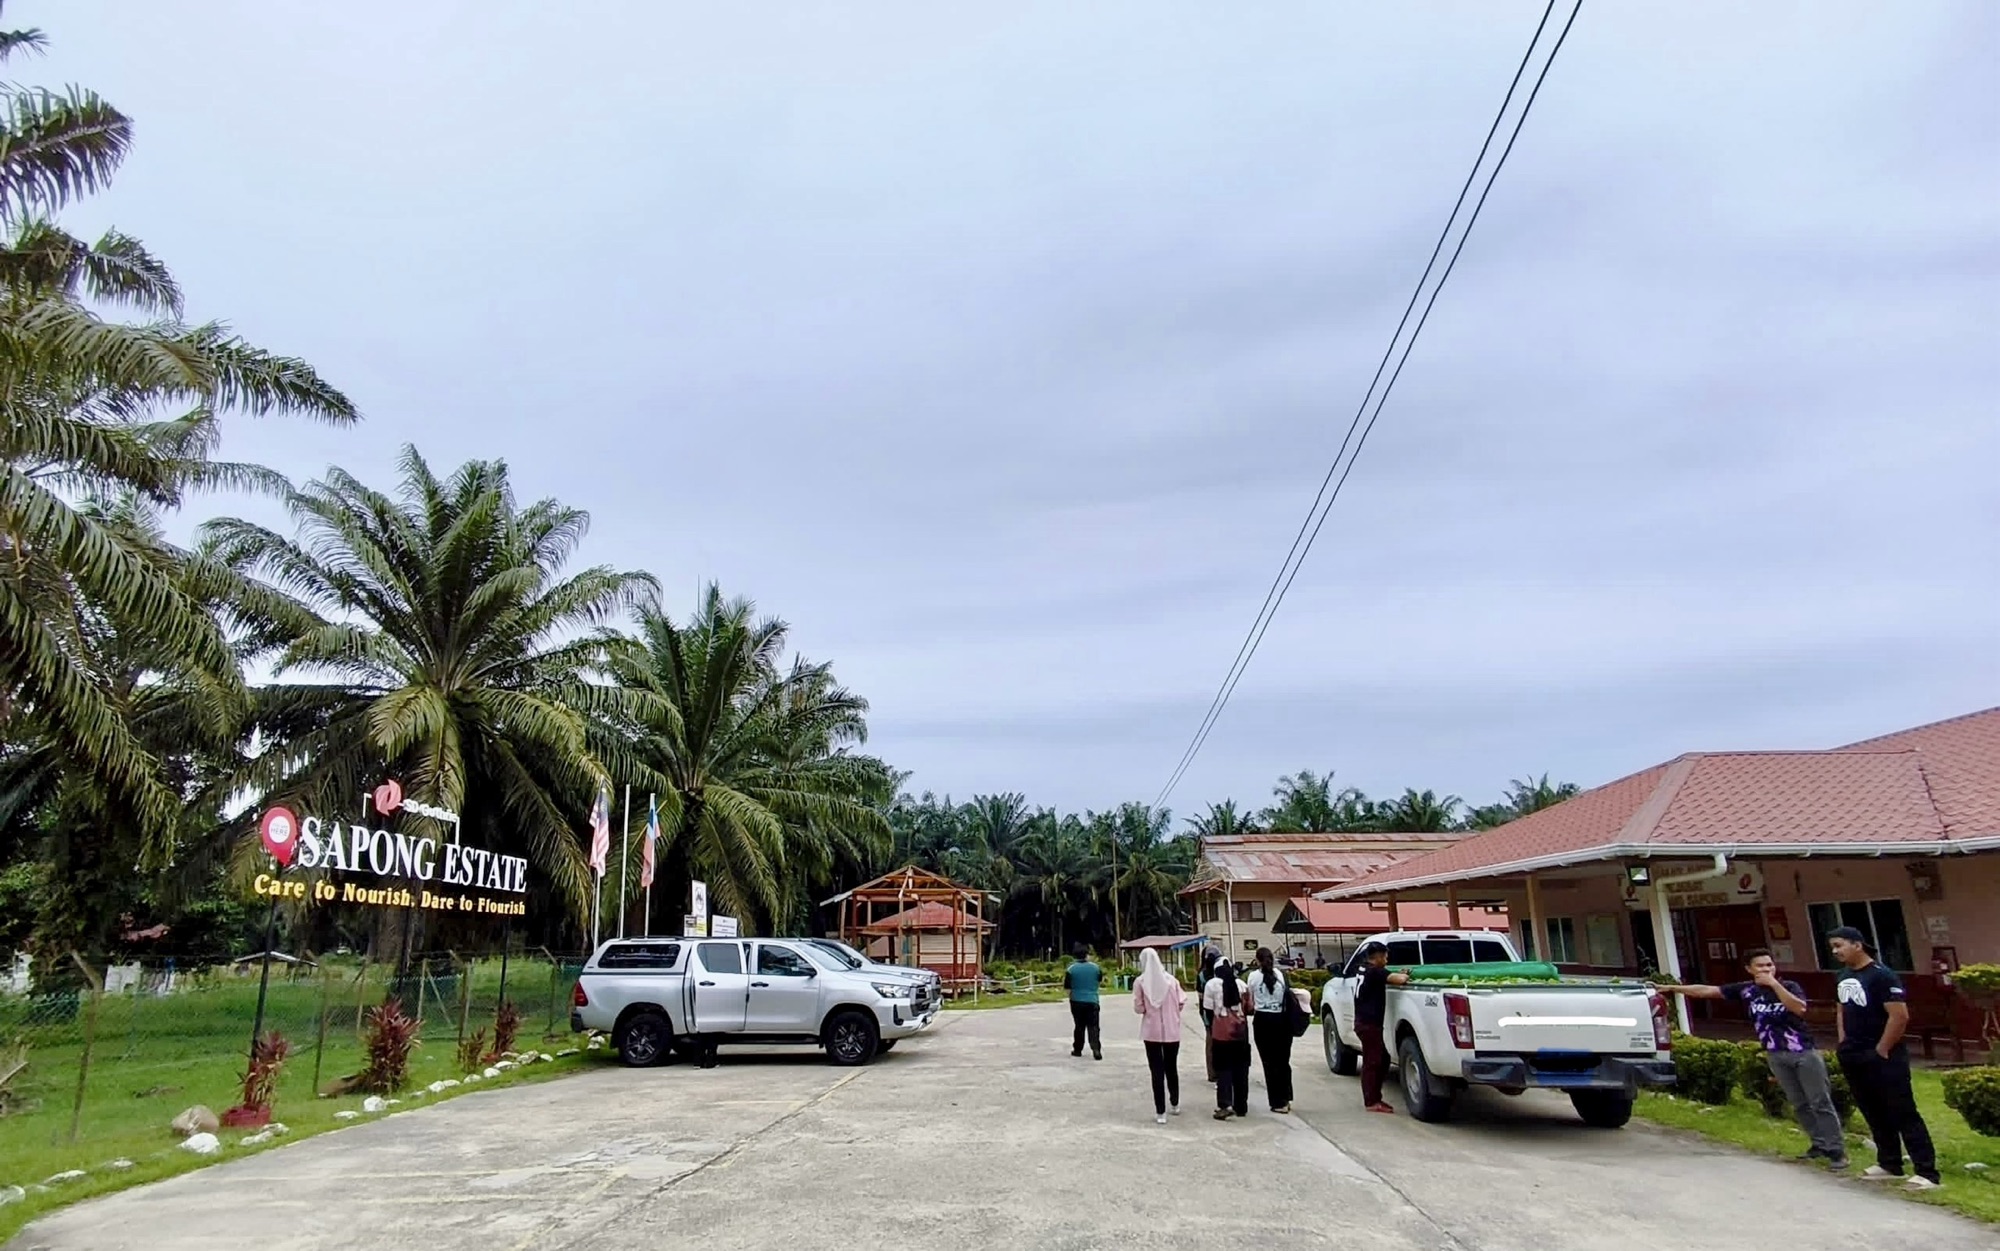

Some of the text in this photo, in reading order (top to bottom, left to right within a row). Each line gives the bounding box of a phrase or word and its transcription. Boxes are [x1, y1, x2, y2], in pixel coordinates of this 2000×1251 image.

[298, 816, 528, 893] SAPONG ESTATE
[254, 874, 526, 915] Care to Nourish, Dare to Flourish
